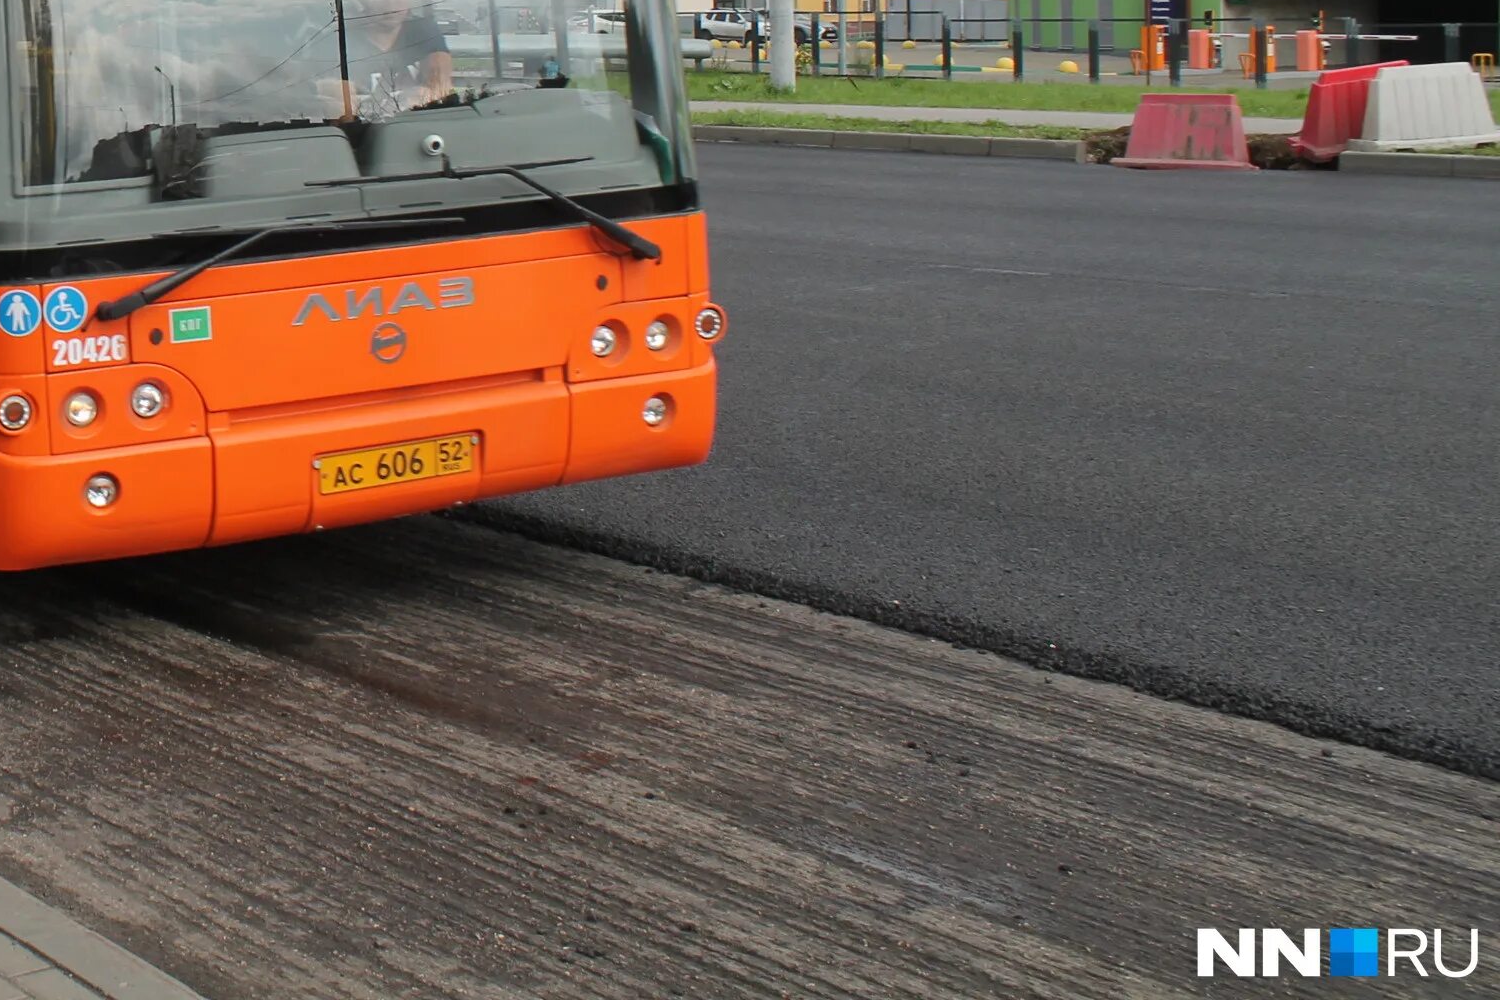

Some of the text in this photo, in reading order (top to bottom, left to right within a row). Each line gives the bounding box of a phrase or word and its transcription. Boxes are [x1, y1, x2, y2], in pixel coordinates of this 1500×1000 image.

[52, 334, 128, 366] 20426
[376, 448, 424, 479] 606
[438, 441, 463, 462] 52
